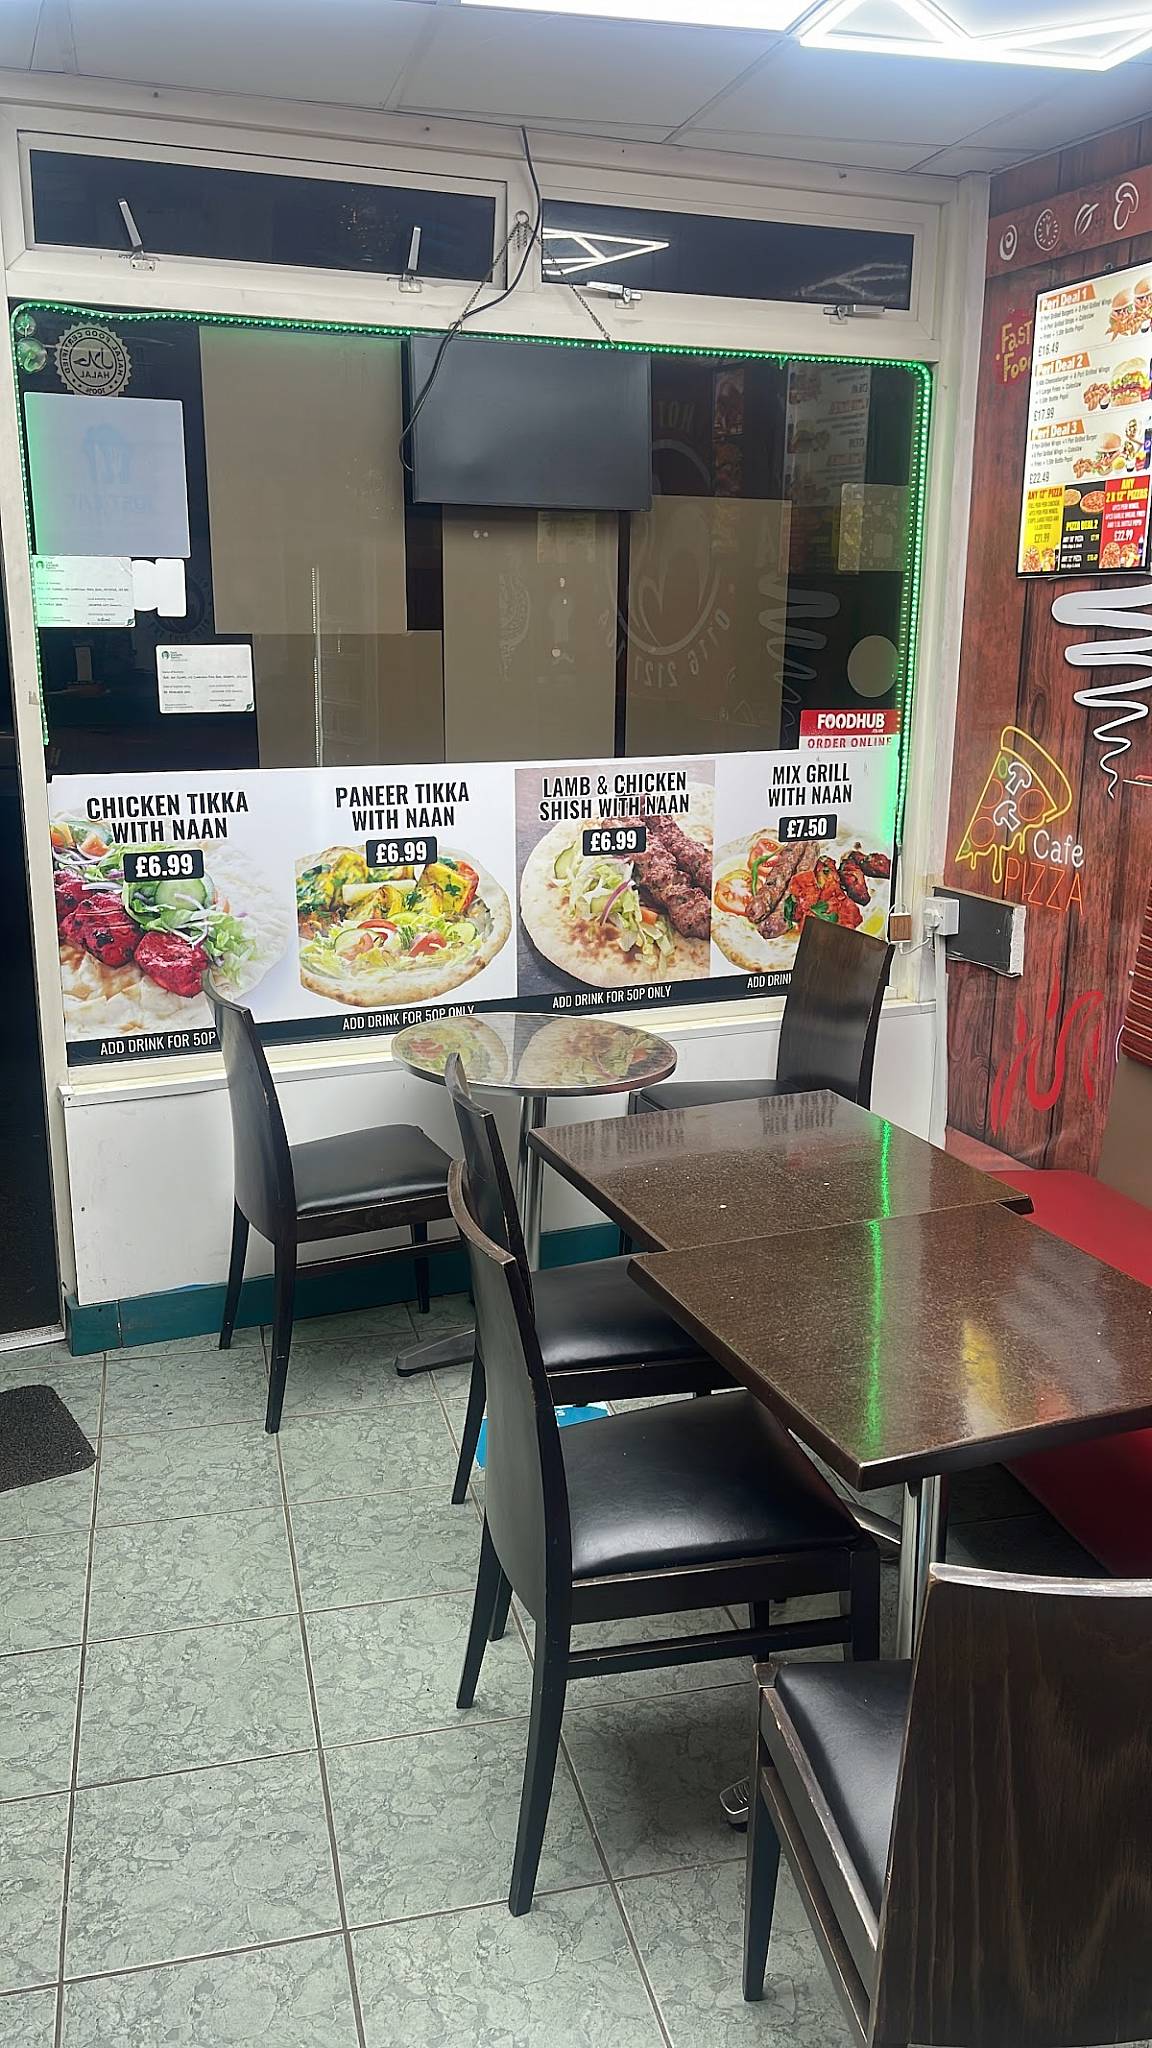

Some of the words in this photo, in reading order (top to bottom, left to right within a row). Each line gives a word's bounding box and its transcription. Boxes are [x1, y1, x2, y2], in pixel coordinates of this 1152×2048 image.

[1081, 287, 1088, 300] 1
[1055, 357, 1075, 372] Deal
[1076, 355, 1083, 368] 2
[1071, 421, 1077, 434] 3
[1028, 490, 1038, 500] ANY
[1048, 487, 1062, 498] PIZZA
[1121, 478, 1135, 490] ANY
[1106, 492, 1111, 503] 2
[1114, 529, 1134, 542] £22.99
[817, 713, 885, 729] FOODHUB
[808, 738, 846, 749] ORDER
[542, 776, 591, 798] LAMB
[597, 776, 609, 794] &
[613, 771, 687, 795] CHICKEN
[772, 765, 801, 785] MIX
[805, 762, 850, 784] GRILL
[335, 785, 409, 808] PANEER
[414, 781, 470, 804] TIKKA
[768, 785, 805, 808] WITH
[811, 784, 853, 805] NAAN
[86, 794, 180, 822] CHICKEN
[185, 791, 249, 816] TIKKA
[539, 799, 592, 821] SHISH
[598, 797, 640, 818] WITH
[646, 794, 690, 815] NAAN
[351, 808, 399, 832] WITH
[405, 806, 456, 829] NAAN
[786, 818, 828, 838] £7.50
[111, 820, 165, 845] WITH
[172, 817, 228, 842] NAAN
[590, 831, 637, 852] £6.99
[375, 841, 428, 864] £6.99
[1032, 830, 1085, 868] Cafe
[135, 854, 194, 878] £6.99
[1004, 857, 1084, 917] PIZZA
[747, 975, 766, 989] ADD
[768, 972, 792, 987] DRIN
[552, 995, 574, 1009] ADD
[575, 992, 603, 1007] DRINK
[606, 990, 625, 1004] FOR
[626, 988, 646, 1002] 50P
[647, 984, 672, 1000] ONLY
[342, 1015, 365, 1031] ADD
[367, 1012, 400, 1028] DRINK
[402, 1010, 423, 1025] FOR
[425, 1008, 446, 1021] 50P
[448, 1005, 476, 1018] ONLY
[100, 1041, 125, 1056] ADD
[127, 1036, 164, 1052] DRINK
[167, 1033, 190, 1049] FOR
[193, 1031, 217, 1046] 50P
